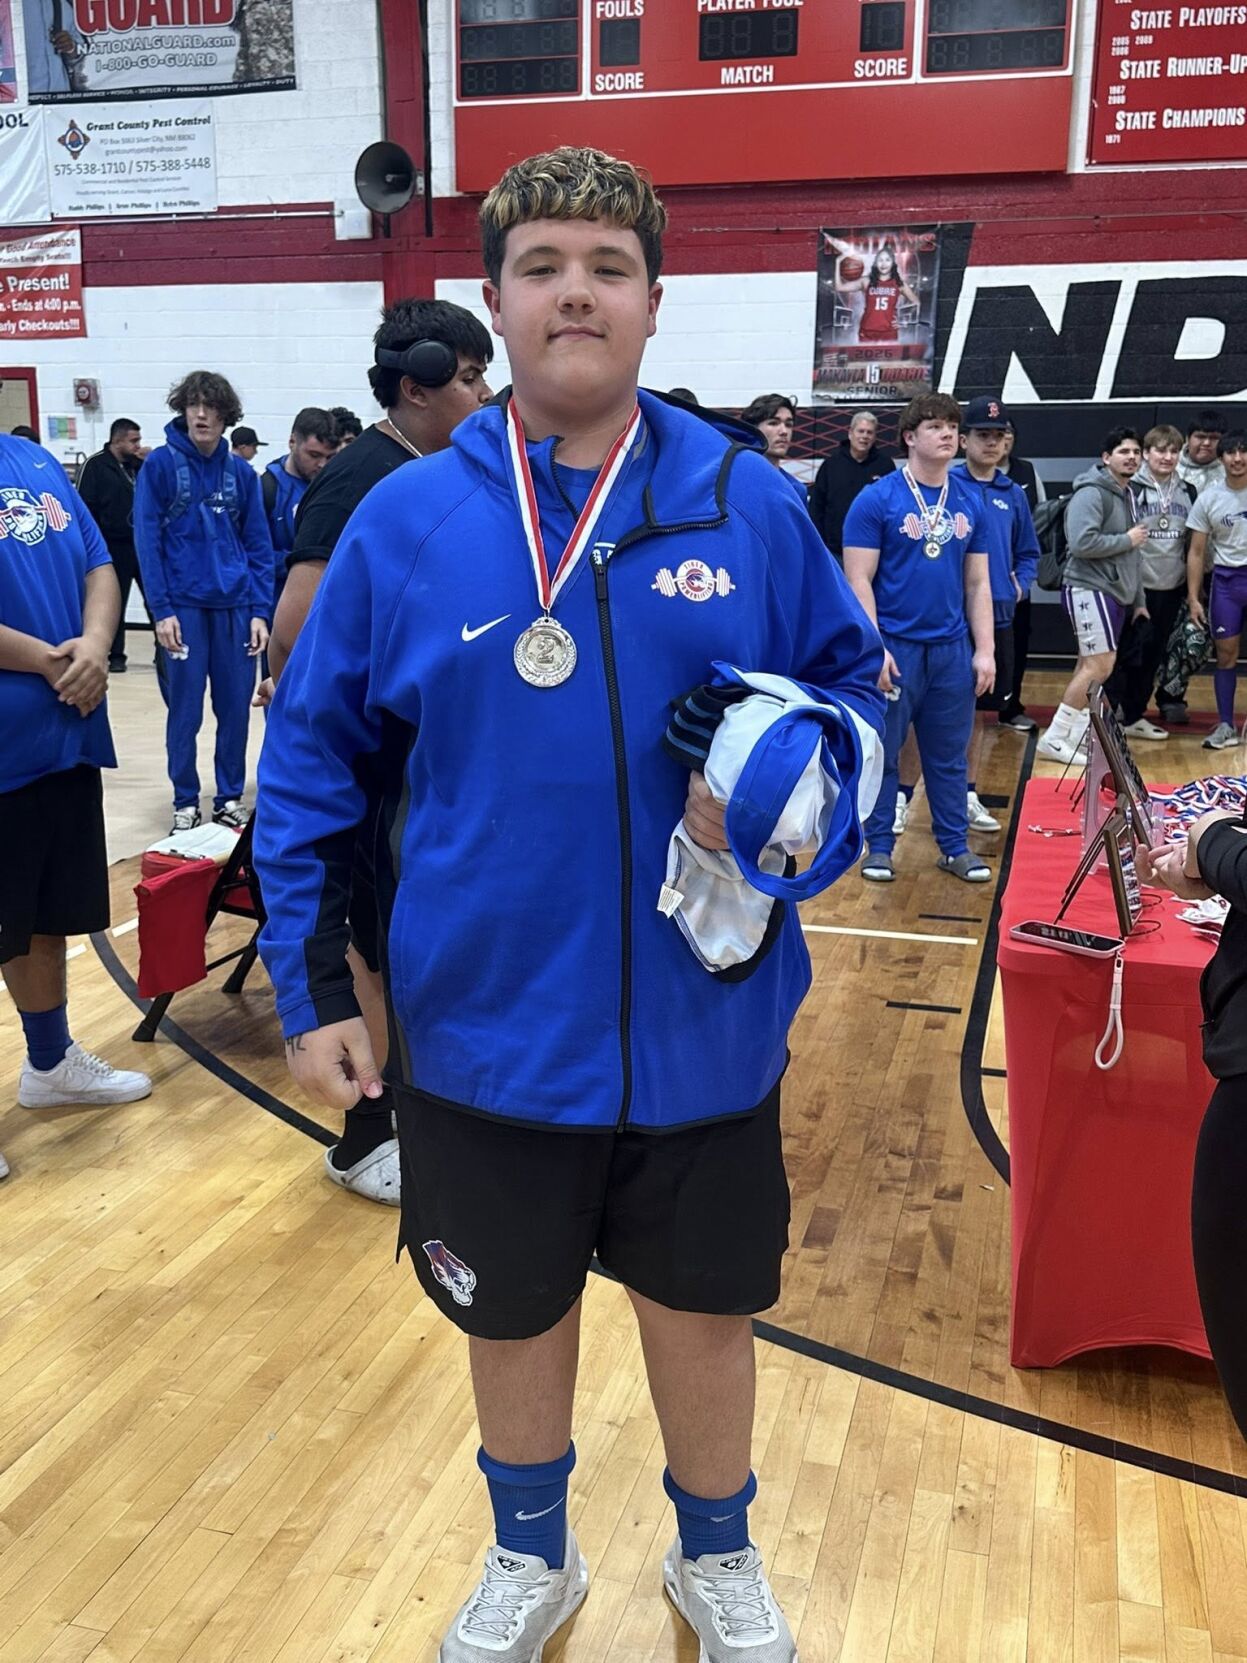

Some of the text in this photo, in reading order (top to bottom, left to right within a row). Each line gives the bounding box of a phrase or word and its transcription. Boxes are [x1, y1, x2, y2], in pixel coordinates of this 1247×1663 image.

[596, 0, 645, 18] FOULS
[1130, 6, 1247, 30] STATE PLAYOFFS
[76, 35, 236, 55] NATIONALGUARD.com
[96, 53, 218, 73] 1-800-GO-GUARD
[854, 57, 908, 78] SCORE
[1120, 54, 1247, 80] STATE RUNNER-UP
[595, 72, 645, 91] SCORE
[721, 65, 774, 85] MATCH
[86, 115, 211, 131] Grant County Pest Control
[1115, 107, 1246, 131] STATE CHAMPIONS
[54, 161, 126, 176] 575-538-1710
[136, 157, 211, 173] 575-388-5448
[6, 272, 70, 292] Present!
[874, 297, 889, 311] 15
[855, 348, 893, 359] 2026
[865, 363, 880, 384] 15
[847, 386, 897, 397] SENIOR
